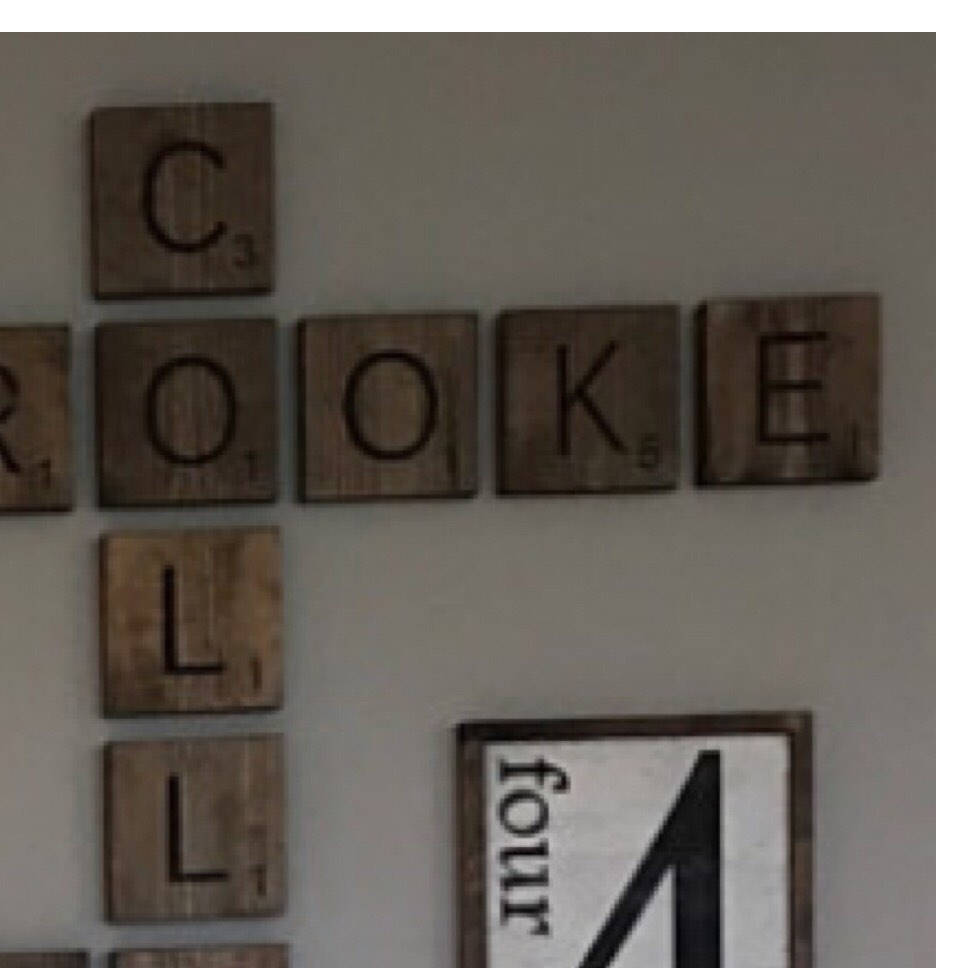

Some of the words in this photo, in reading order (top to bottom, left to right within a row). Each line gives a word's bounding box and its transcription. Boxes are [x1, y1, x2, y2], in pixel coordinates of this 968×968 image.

[232, 234, 258, 268] 3
[38, 458, 52, 490] 1
[249, 655, 263, 692] 1
[498, 756, 571, 936] four
[251, 863, 268, 897] 1
